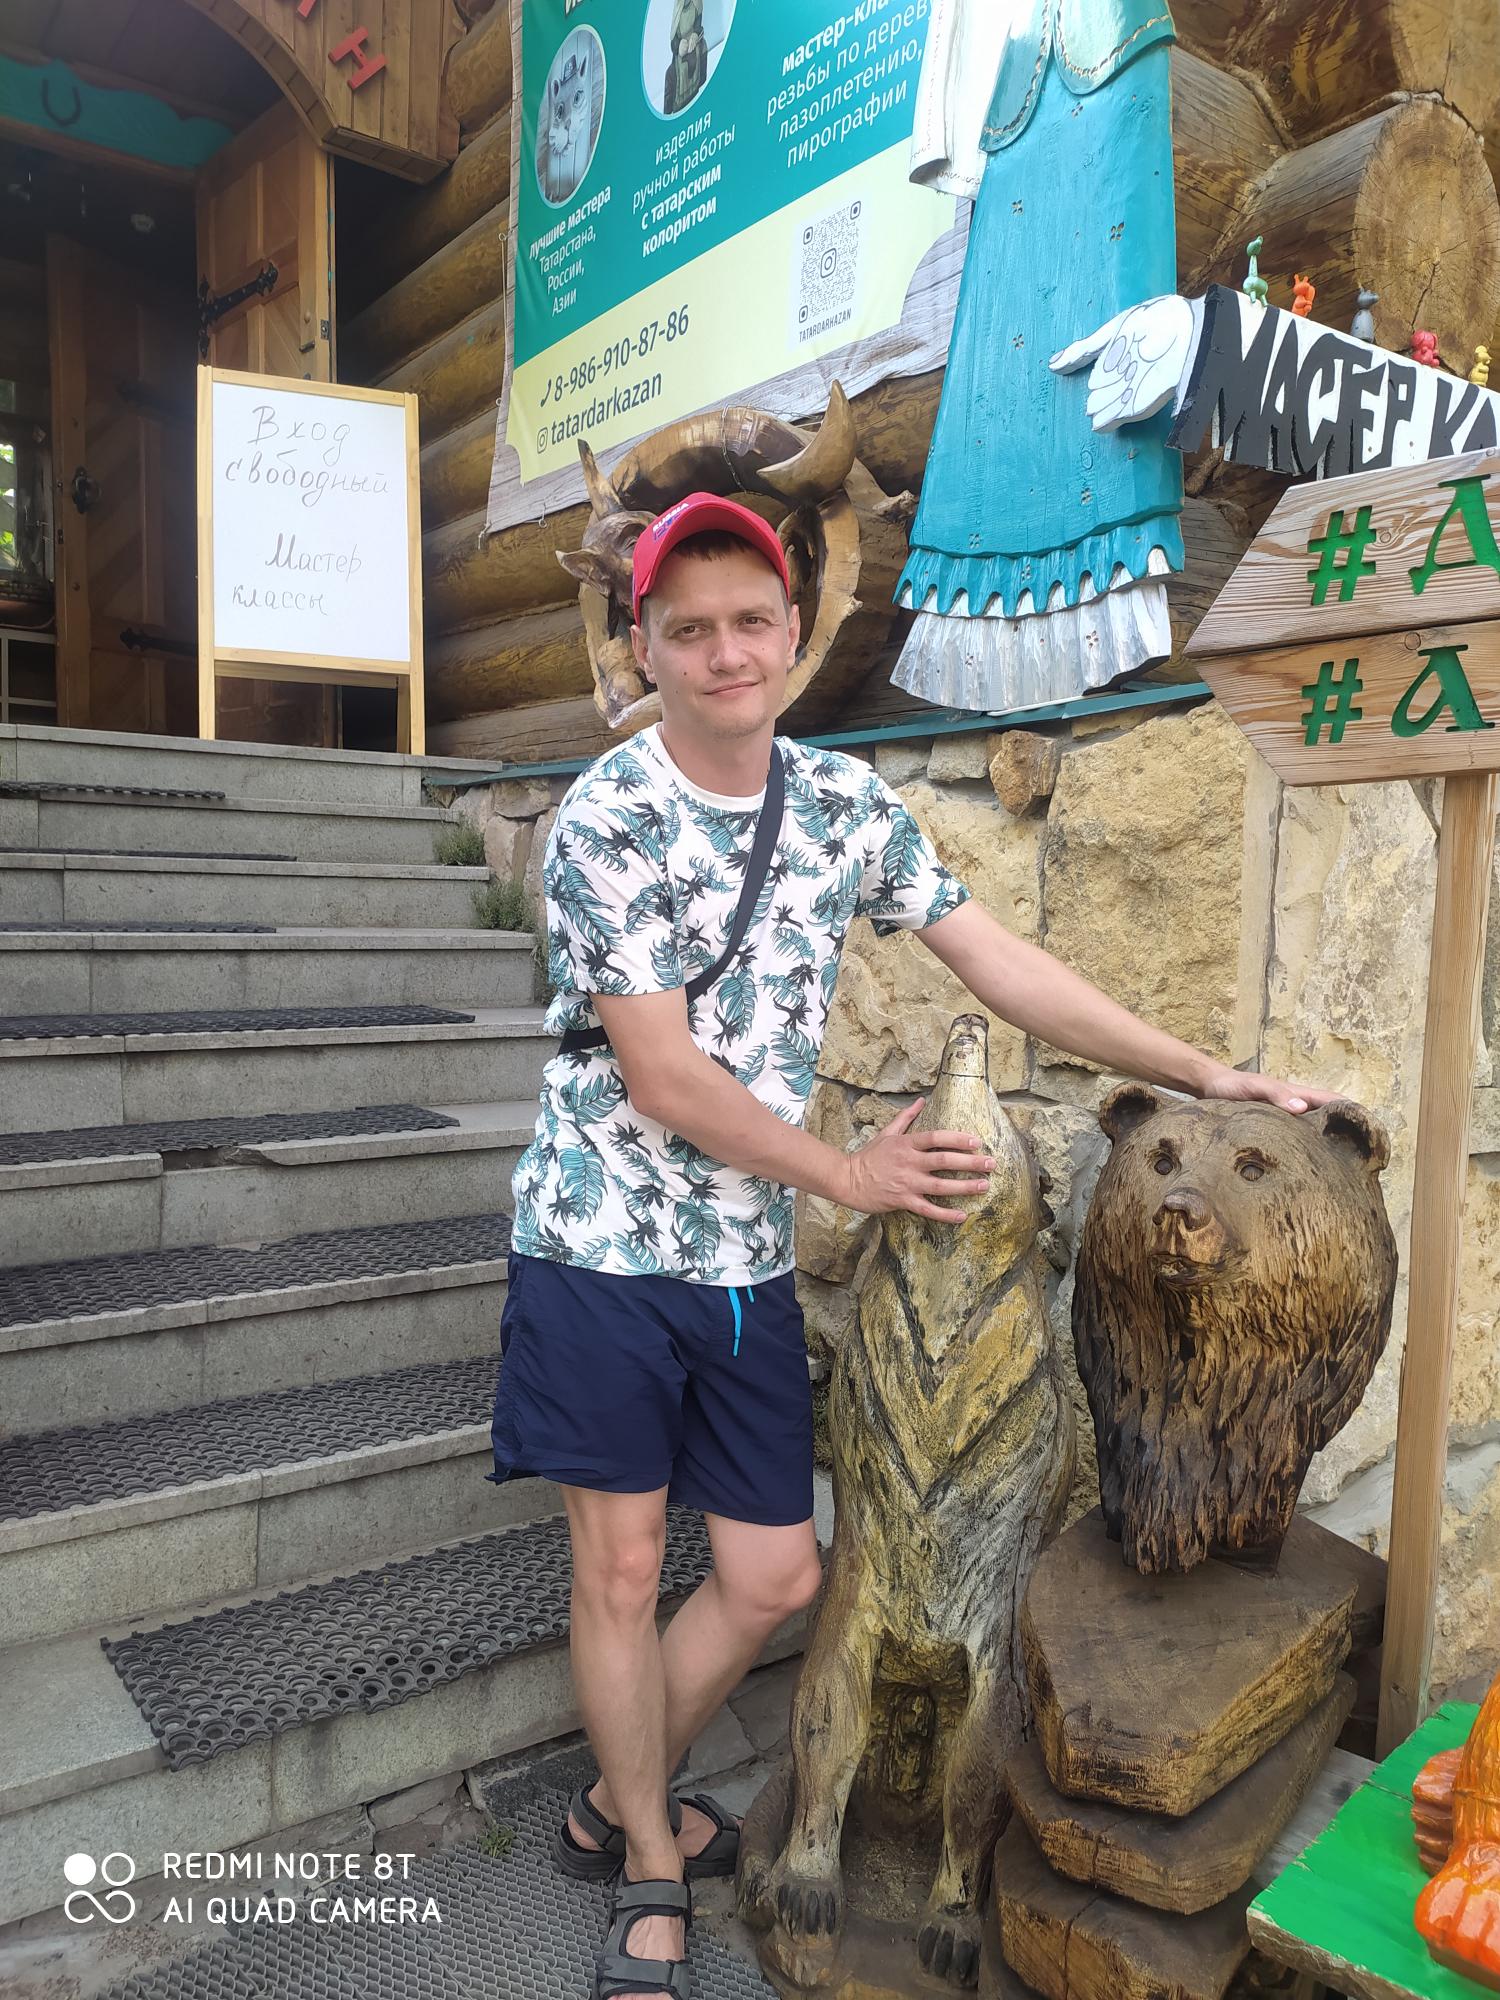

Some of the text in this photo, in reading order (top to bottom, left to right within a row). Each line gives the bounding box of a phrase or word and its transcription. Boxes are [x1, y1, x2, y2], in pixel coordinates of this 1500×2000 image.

[766, 0, 933, 124] резьбы по дерев
[778, 39, 924, 142] лазоплетению,
[655, 110, 712, 166] изделия
[787, 79, 908, 168] пирографии
[632, 123, 736, 215] ручной работы
[641, 163, 722, 231] с татарским
[529, 185, 612, 260] лучшие мастера
[539, 224, 597, 275] Татарстана,
[642, 196, 717, 258] колоритом
[547, 258, 585, 295] России,
[551, 288, 577, 317] Азии
[554, 304, 689, 402] 8-986-910-87-86
[1165, 284, 1417, 481] МАСТЕР
[247, 405, 351, 466] Вход
[551, 372, 662, 445] tatardarkazan
[225, 448, 389, 508] свободный
[264, 532, 362, 581] Мастер
[231, 583, 328, 616] классы
